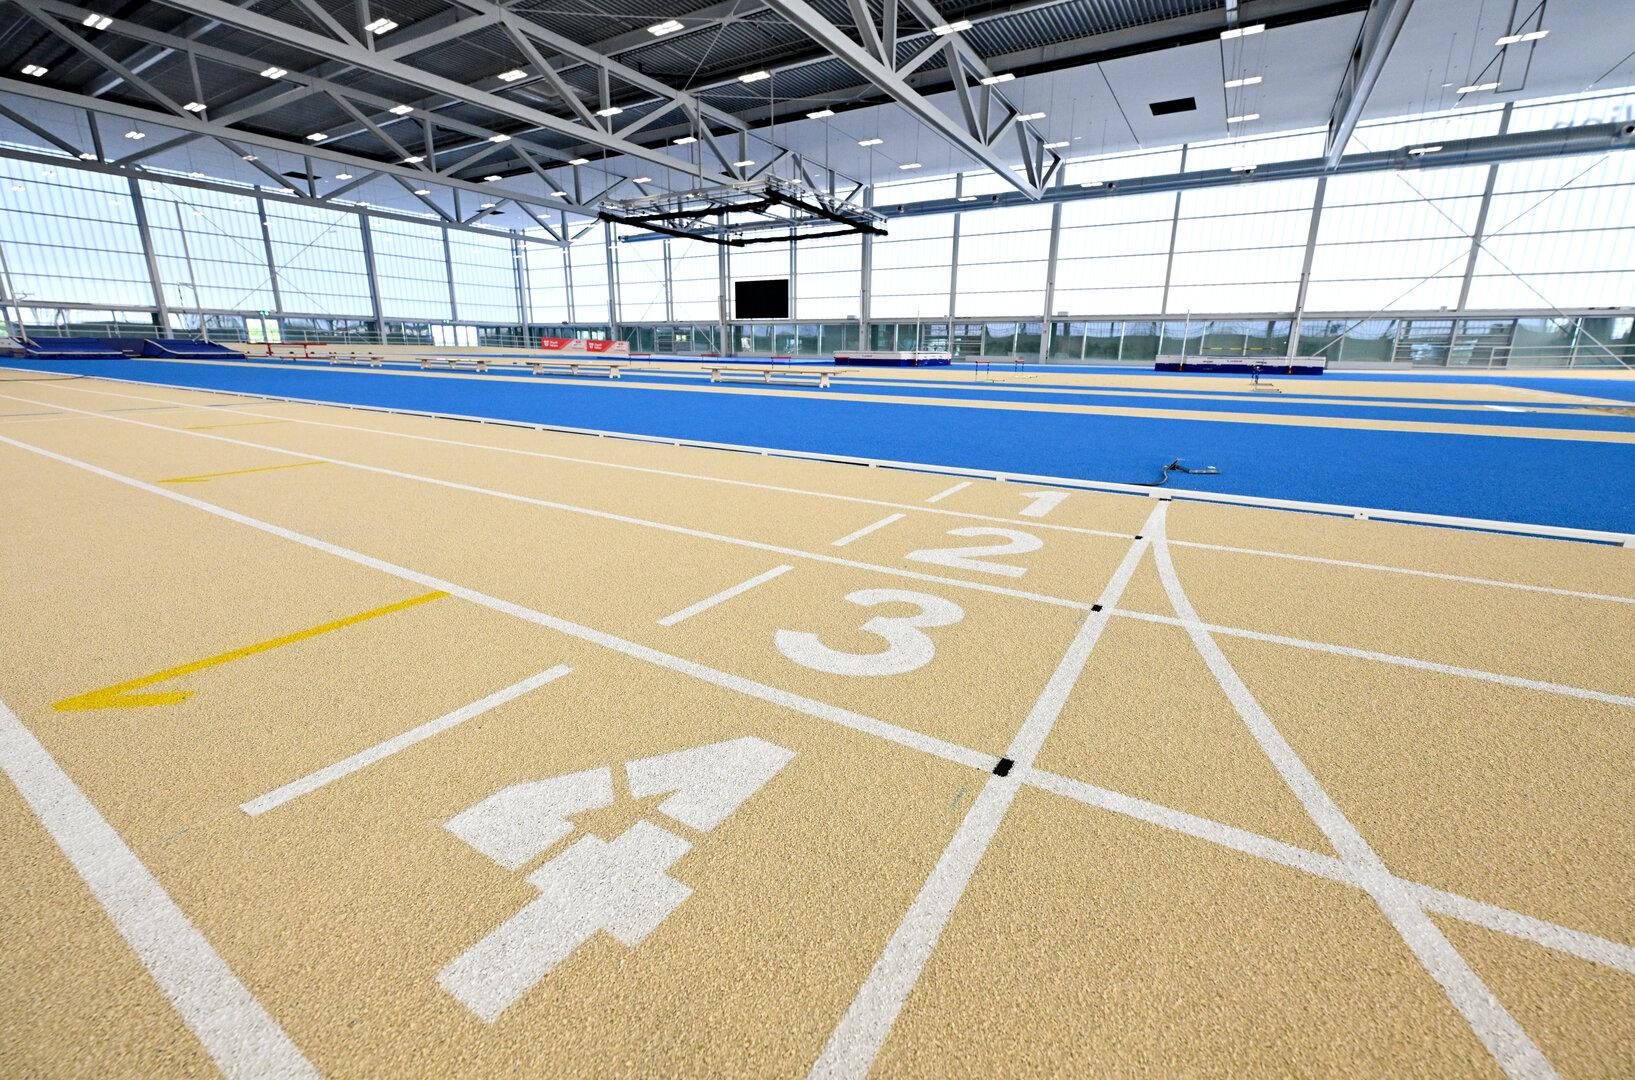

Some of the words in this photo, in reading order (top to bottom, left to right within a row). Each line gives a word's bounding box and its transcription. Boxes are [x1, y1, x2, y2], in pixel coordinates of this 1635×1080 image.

[1020, 491, 1070, 517] 1
[905, 527, 1043, 577] 2
[774, 588, 965, 676] 3
[436, 736, 797, 1024] 4
